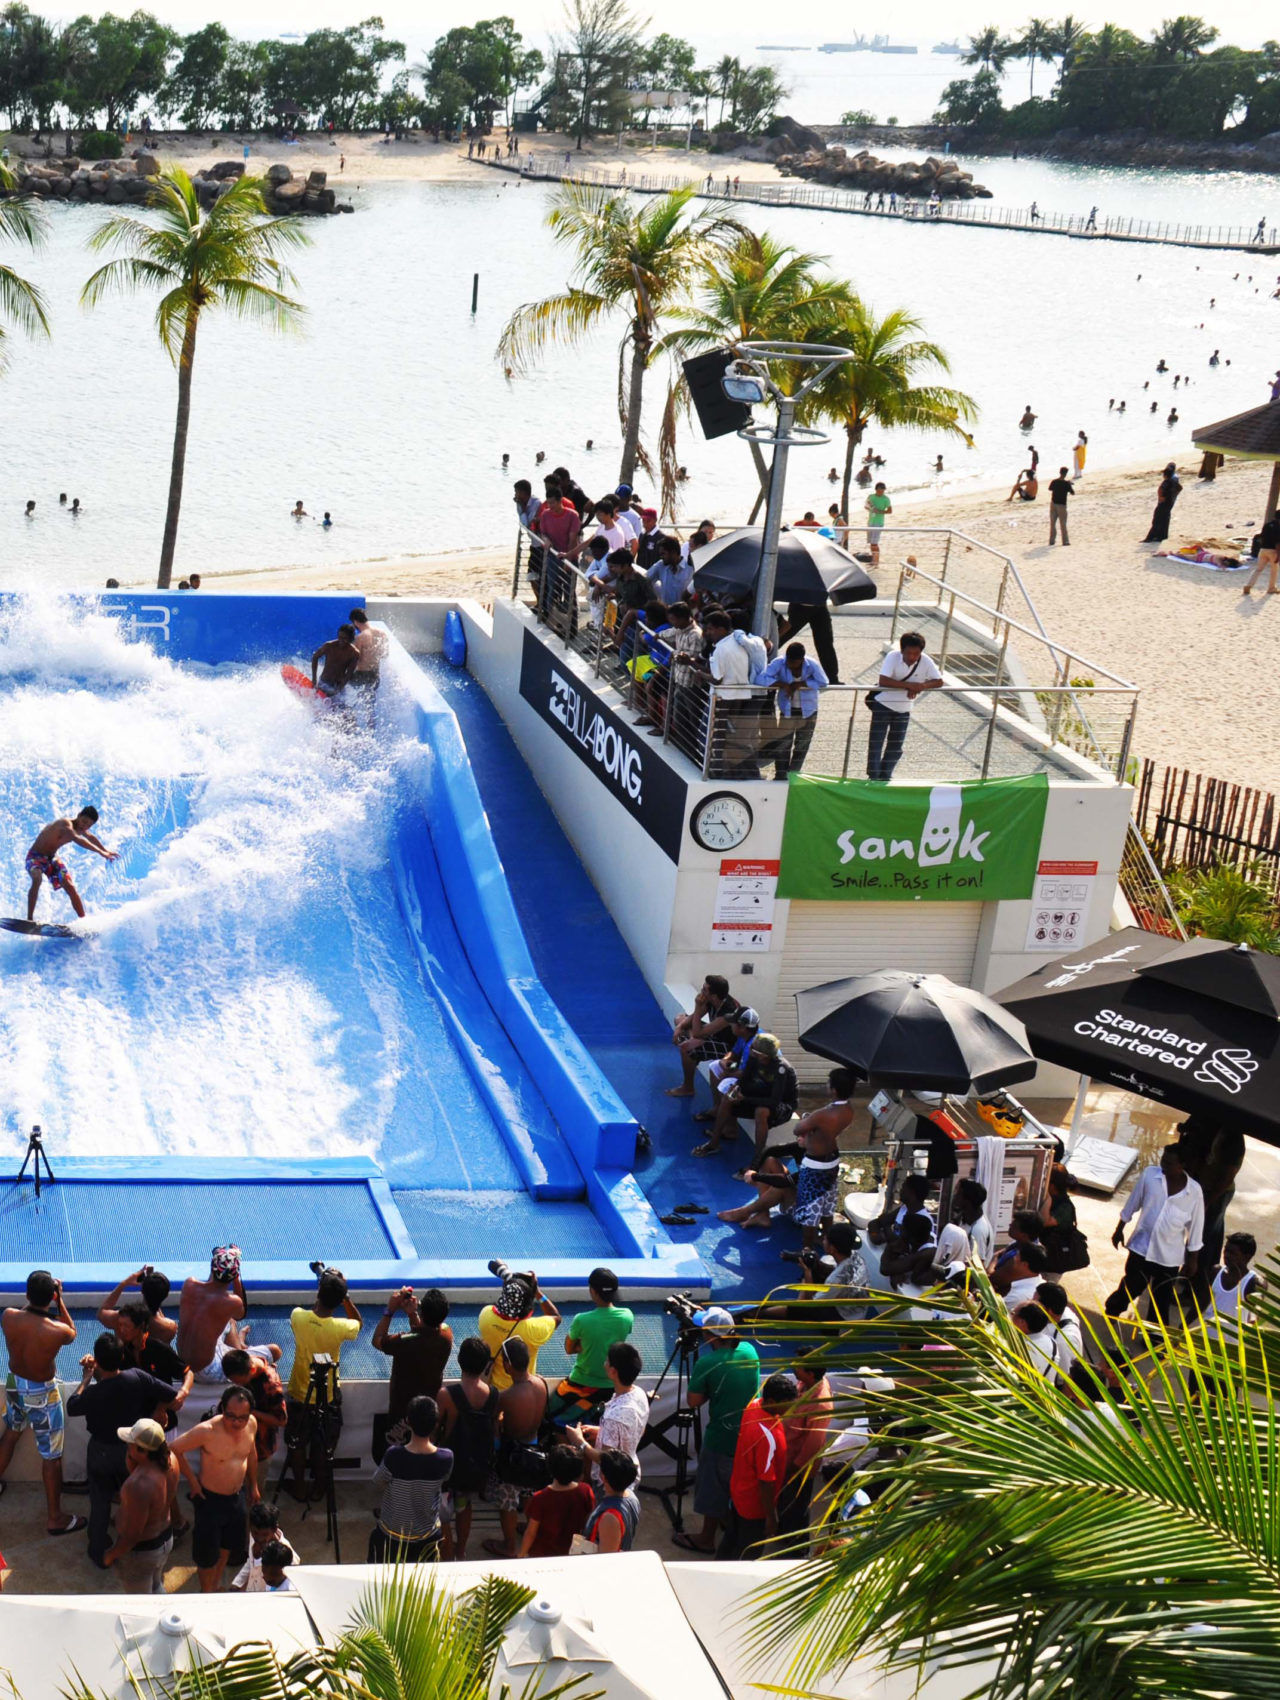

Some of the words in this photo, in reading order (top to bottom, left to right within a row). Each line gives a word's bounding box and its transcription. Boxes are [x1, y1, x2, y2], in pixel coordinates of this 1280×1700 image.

[936, 871, 950, 888] it
[956, 870, 984, 888] on!
[1074, 1021, 1194, 1070] Chartered
[1095, 1009, 1207, 1056] Standard
